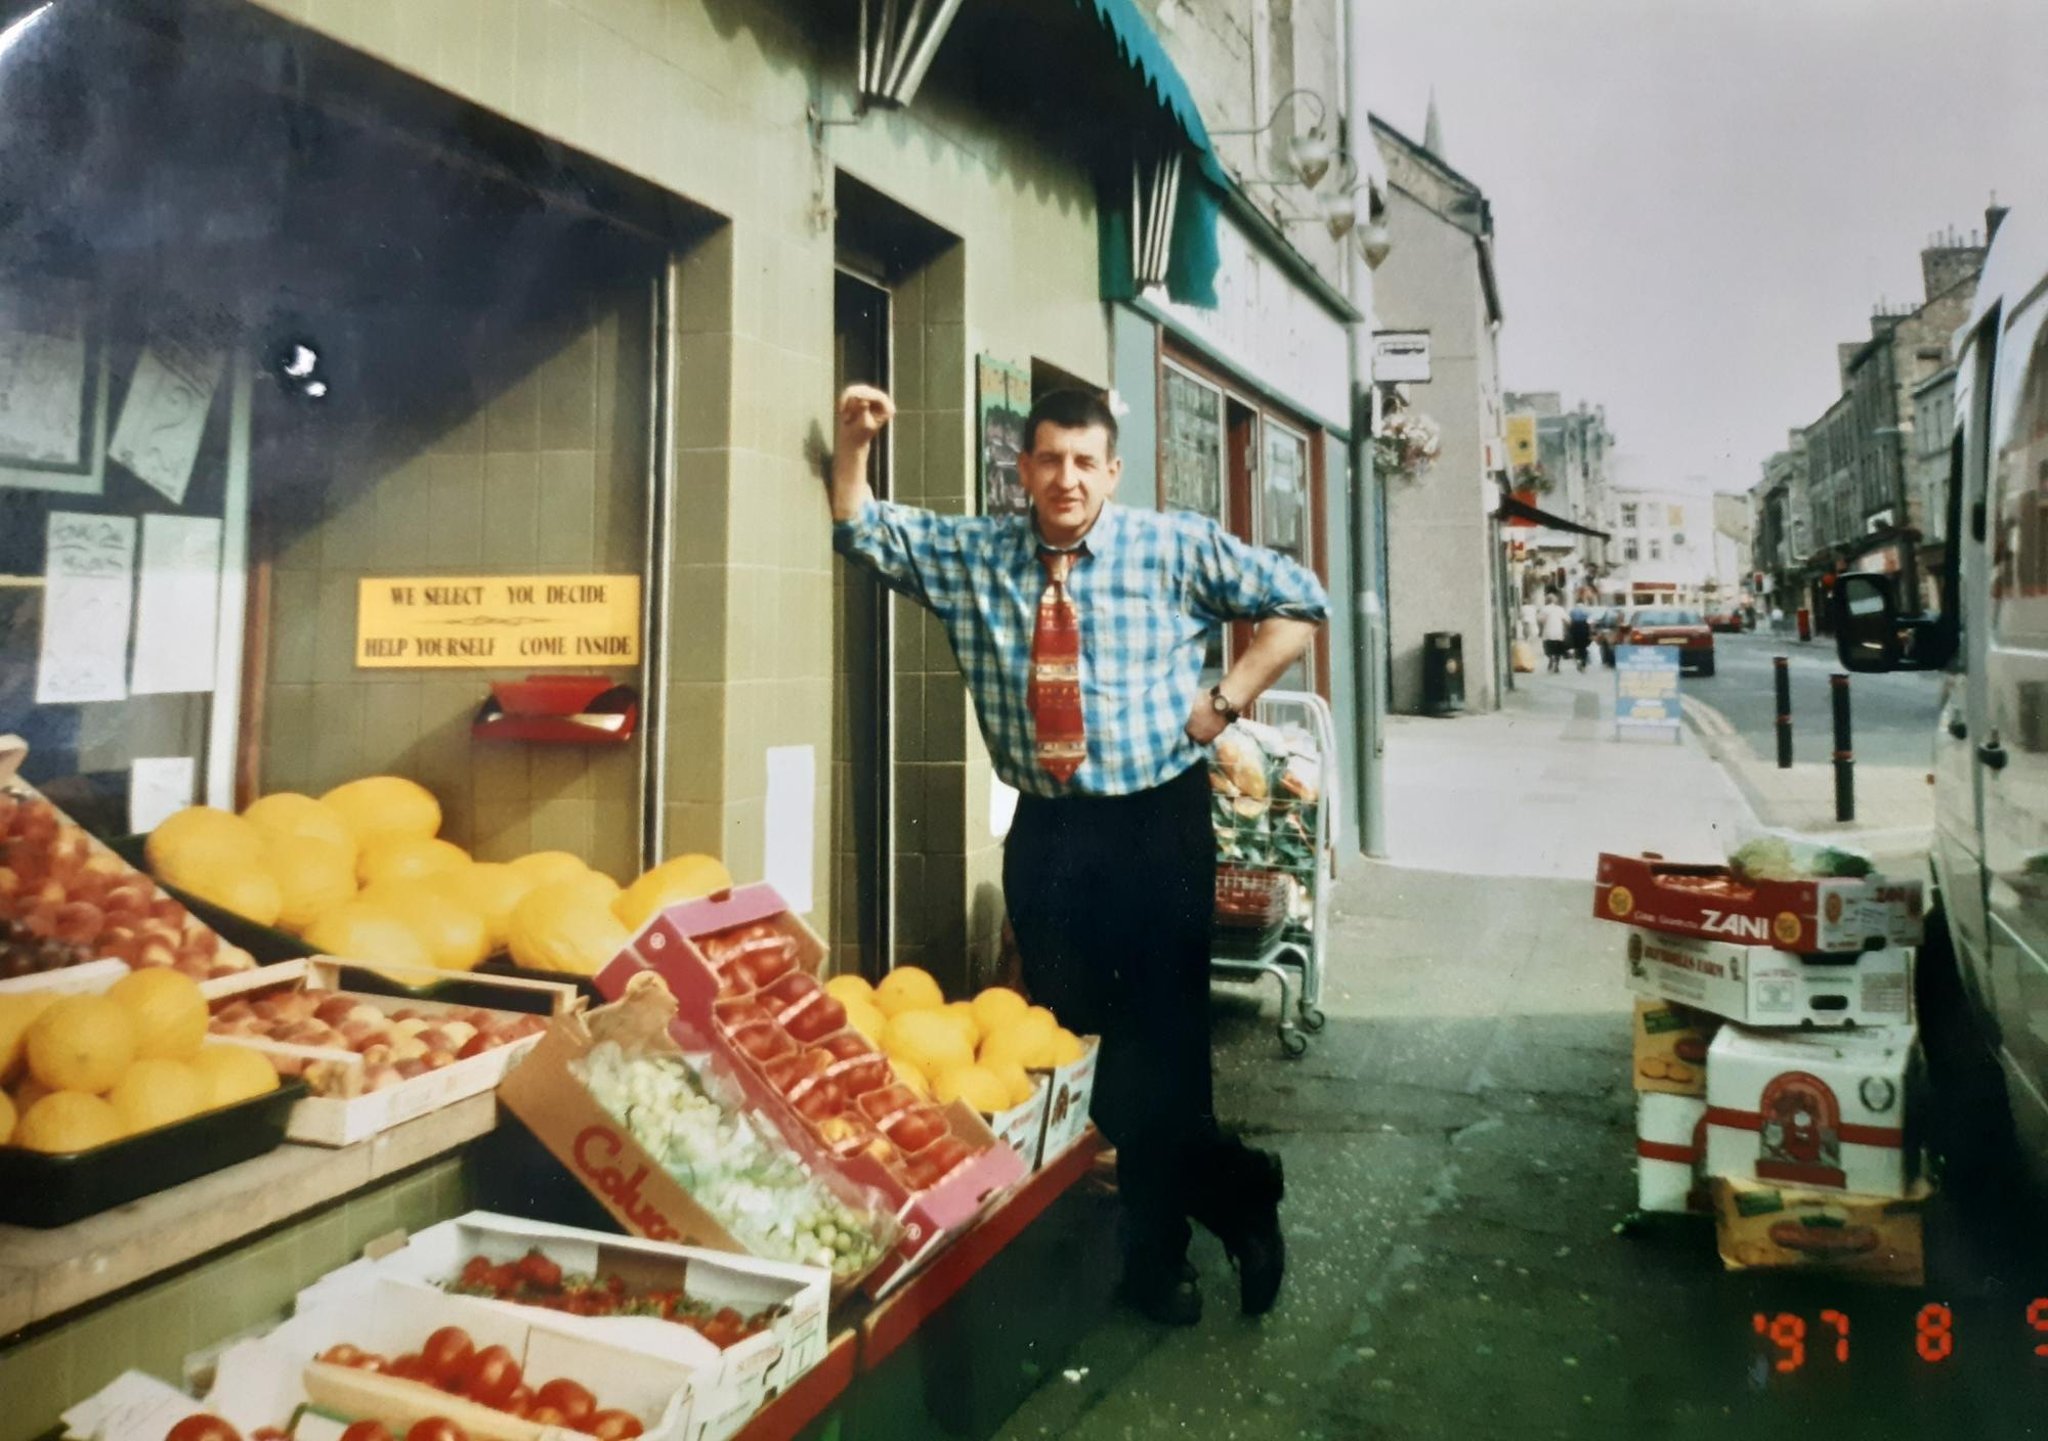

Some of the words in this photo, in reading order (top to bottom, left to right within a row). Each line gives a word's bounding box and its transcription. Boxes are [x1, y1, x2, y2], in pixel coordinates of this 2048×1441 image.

[390, 586, 415, 606] WE
[424, 586, 485, 606] SELECT
[507, 585, 535, 604] YOU
[547, 584, 608, 604] DECIDE
[364, 637, 408, 657] HELP
[415, 637, 496, 656] YOURSELF
[519, 636, 568, 656] COME
[576, 635, 632, 655] INSIDE
[1700, 909, 1770, 940] ZANI
